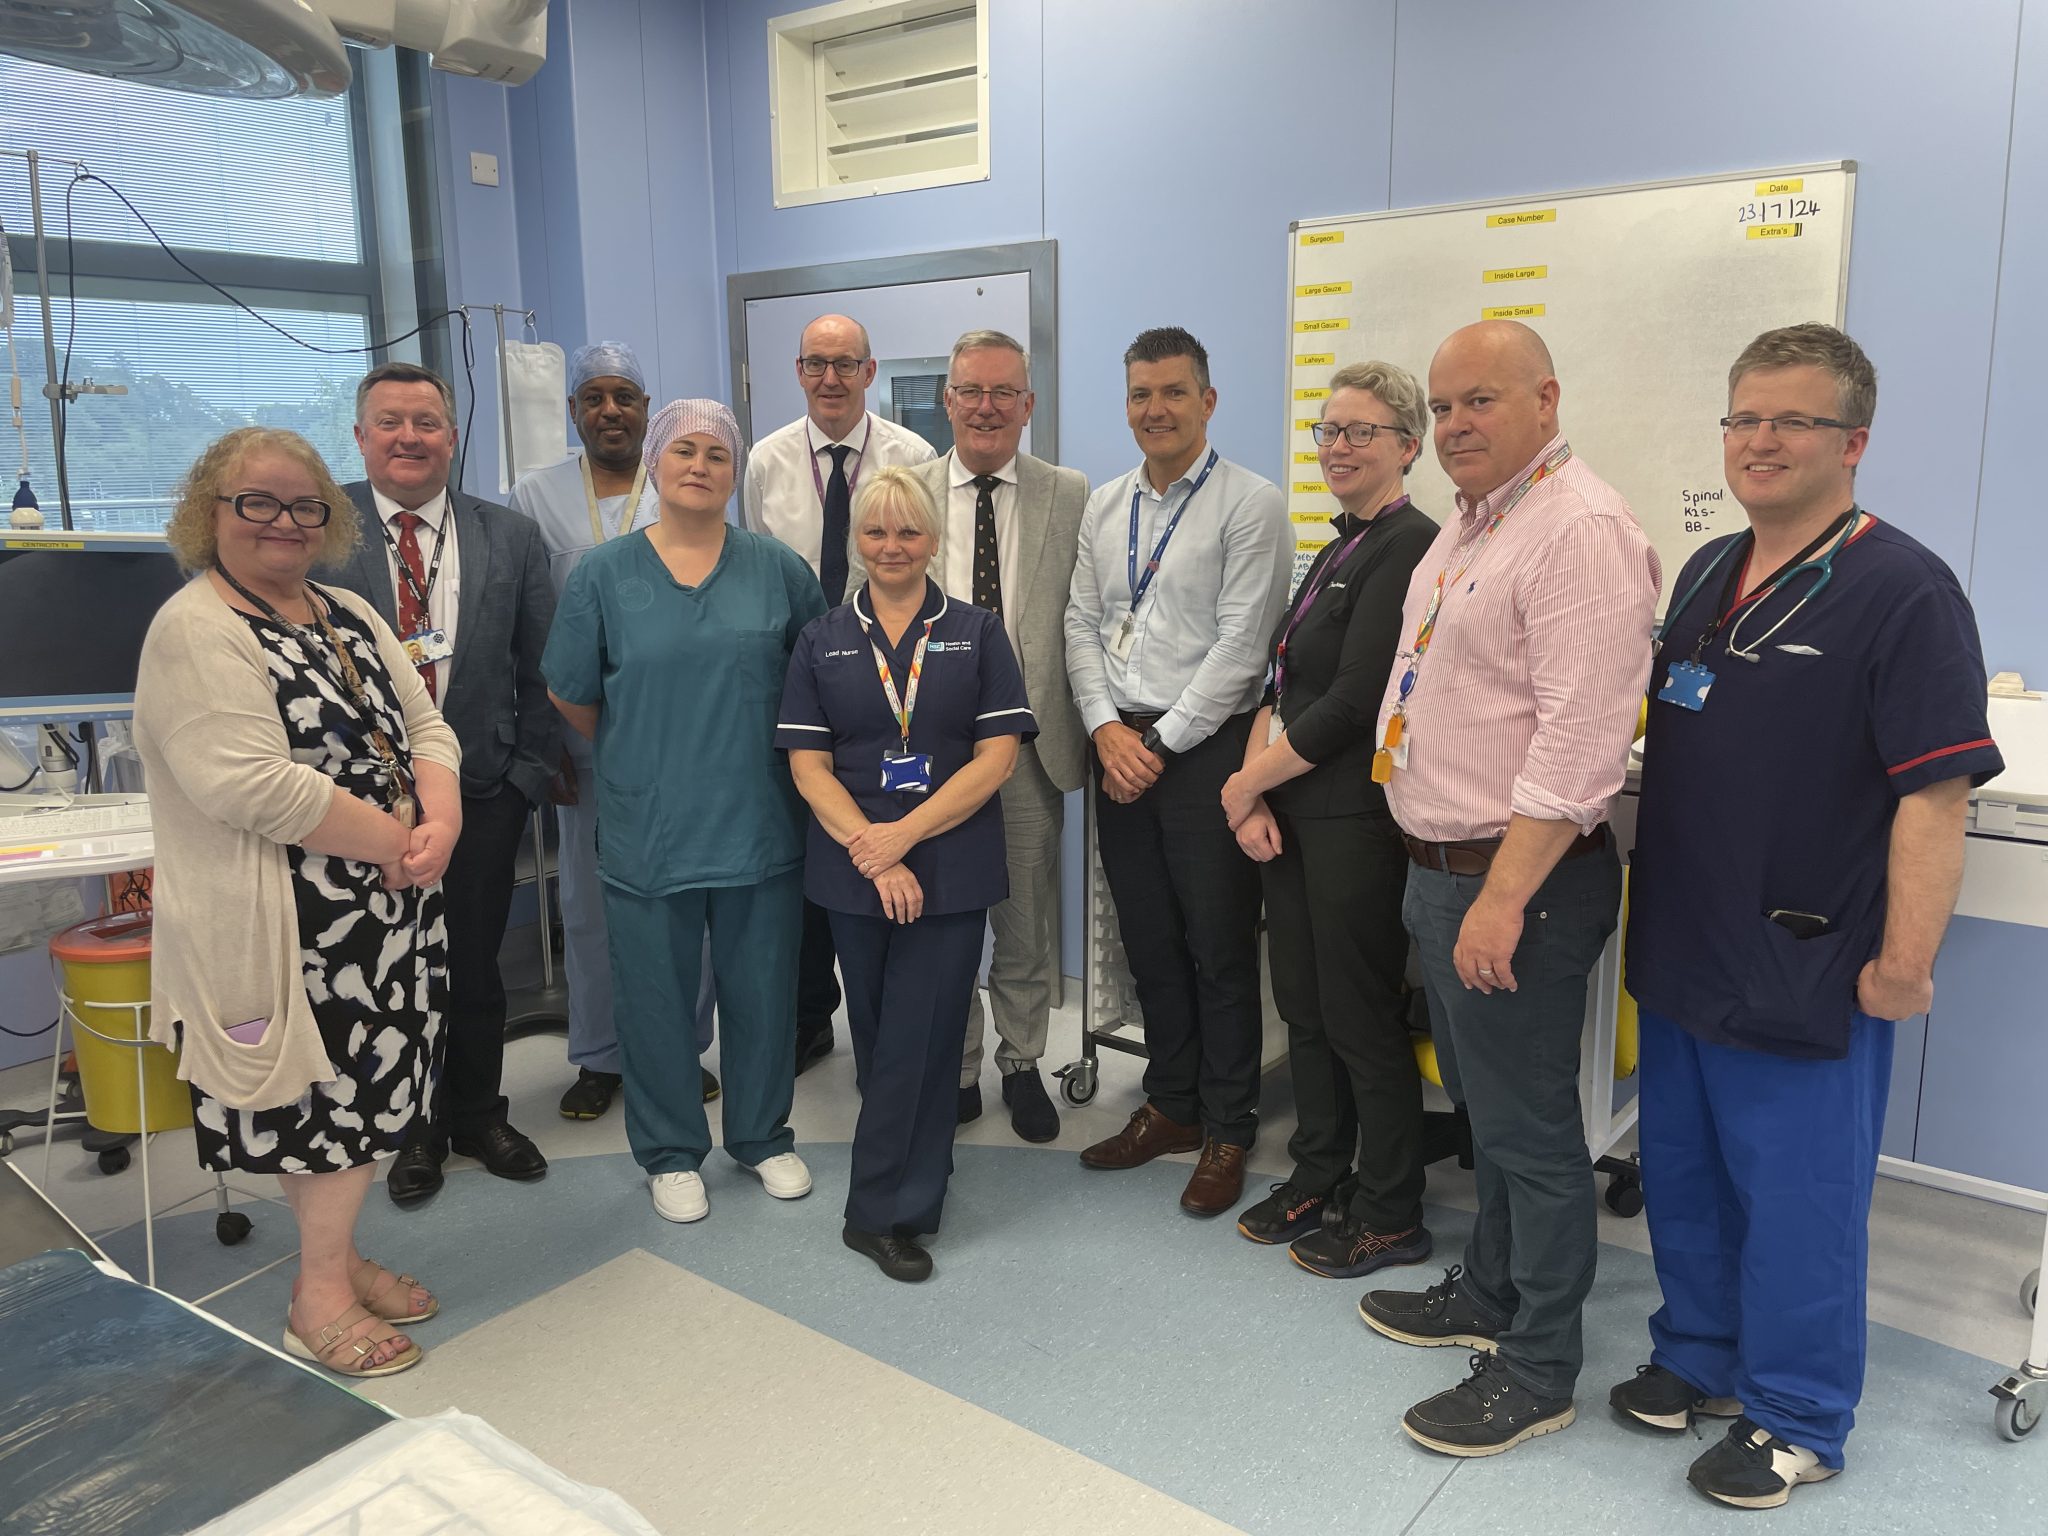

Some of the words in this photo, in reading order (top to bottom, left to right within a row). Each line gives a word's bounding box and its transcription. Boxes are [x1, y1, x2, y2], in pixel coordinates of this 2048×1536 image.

[1769, 184, 1789, 192] Date
[1516, 214, 1544, 222] Number
[1760, 228, 1788, 236] Extra's
[1309, 236, 1334, 244] Surgeon
[1514, 308, 1534, 316] Small
[1682, 488, 1723, 506] Spinal
[826, 650, 840, 658] Lead
